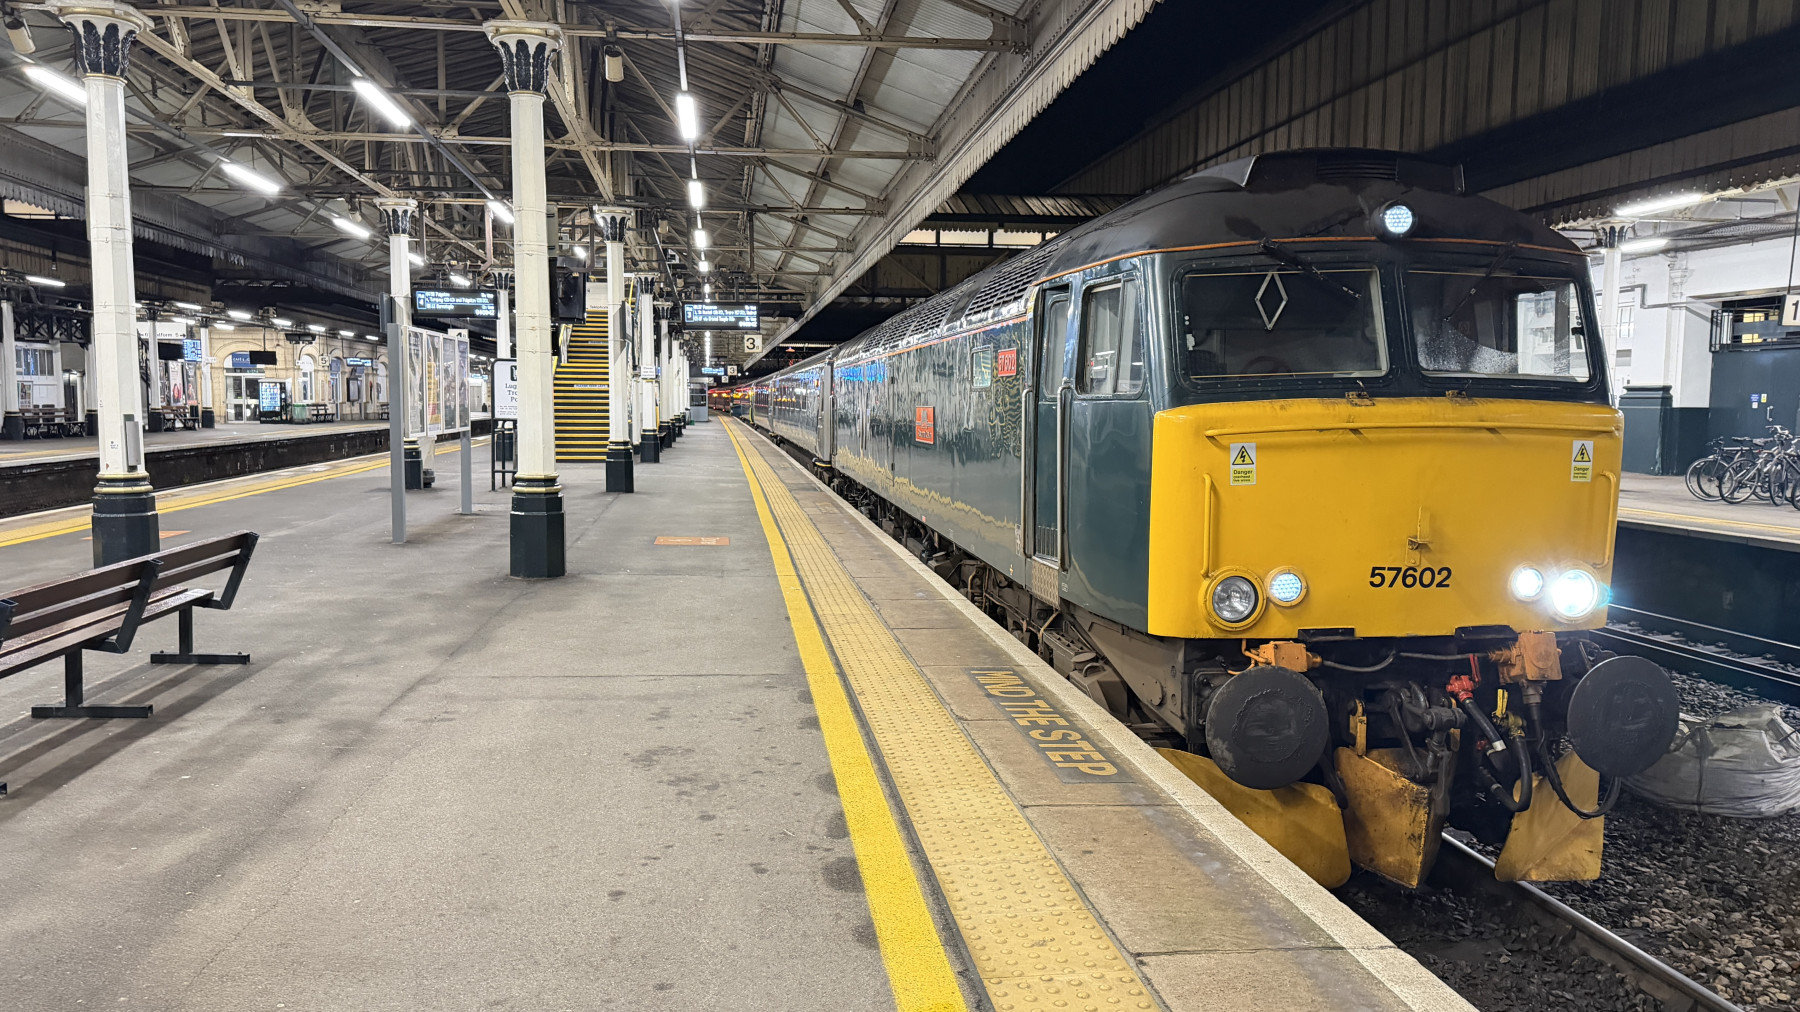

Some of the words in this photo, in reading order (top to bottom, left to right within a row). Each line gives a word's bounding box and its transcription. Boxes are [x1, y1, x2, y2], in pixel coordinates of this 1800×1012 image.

[746, 338, 756, 350] 3
[1369, 566, 1452, 588] 57602
[970, 670, 1036, 698] MIND
[1000, 700, 1070, 726] THE
[1029, 729, 1118, 776] STEP
